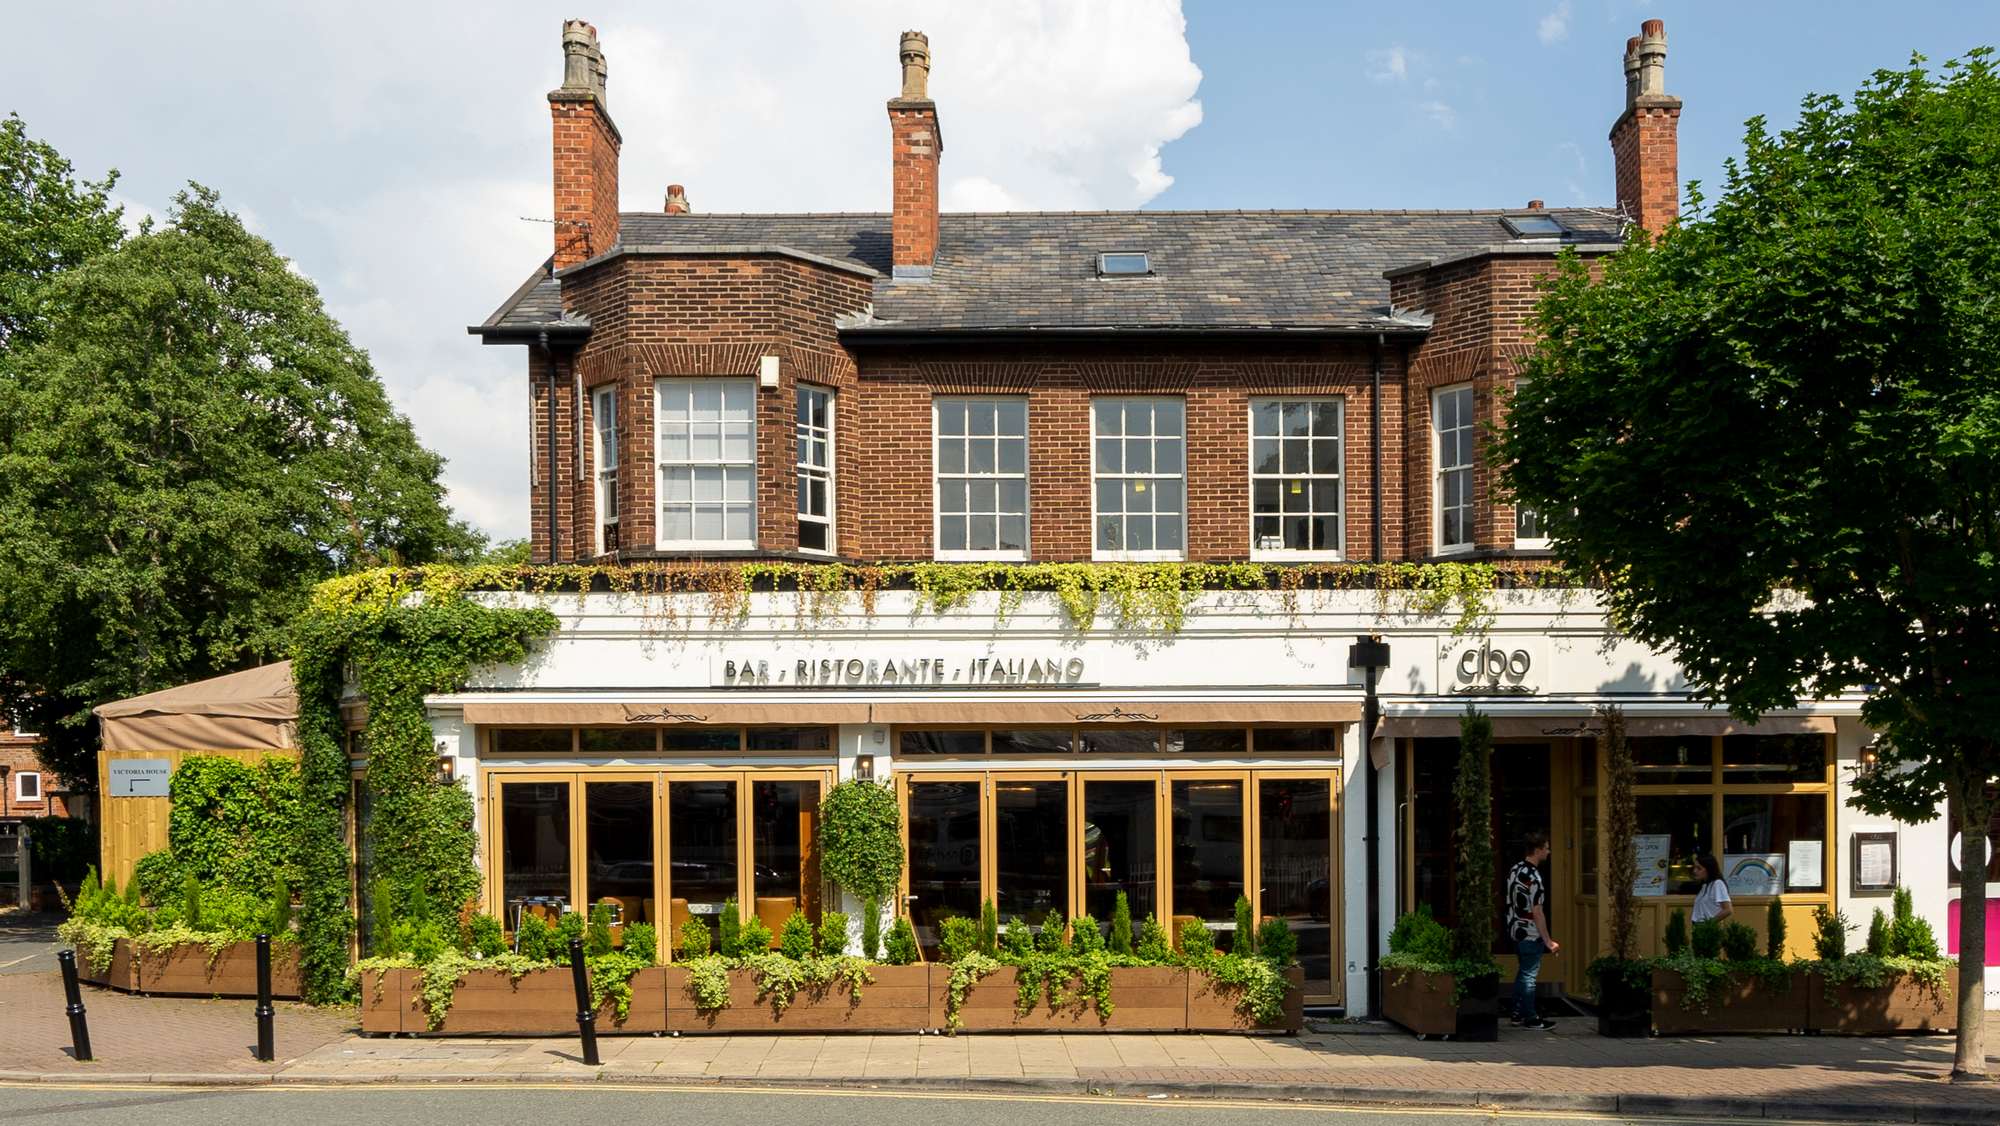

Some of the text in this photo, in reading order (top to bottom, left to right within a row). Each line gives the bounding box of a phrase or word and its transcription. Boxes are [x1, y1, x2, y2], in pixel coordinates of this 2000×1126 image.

[726, 659, 769, 678] BAR
[797, 658, 944, 677] RISTORANTE
[971, 657, 1084, 677] ITALIANO
[1461, 638, 1530, 675] cibo
